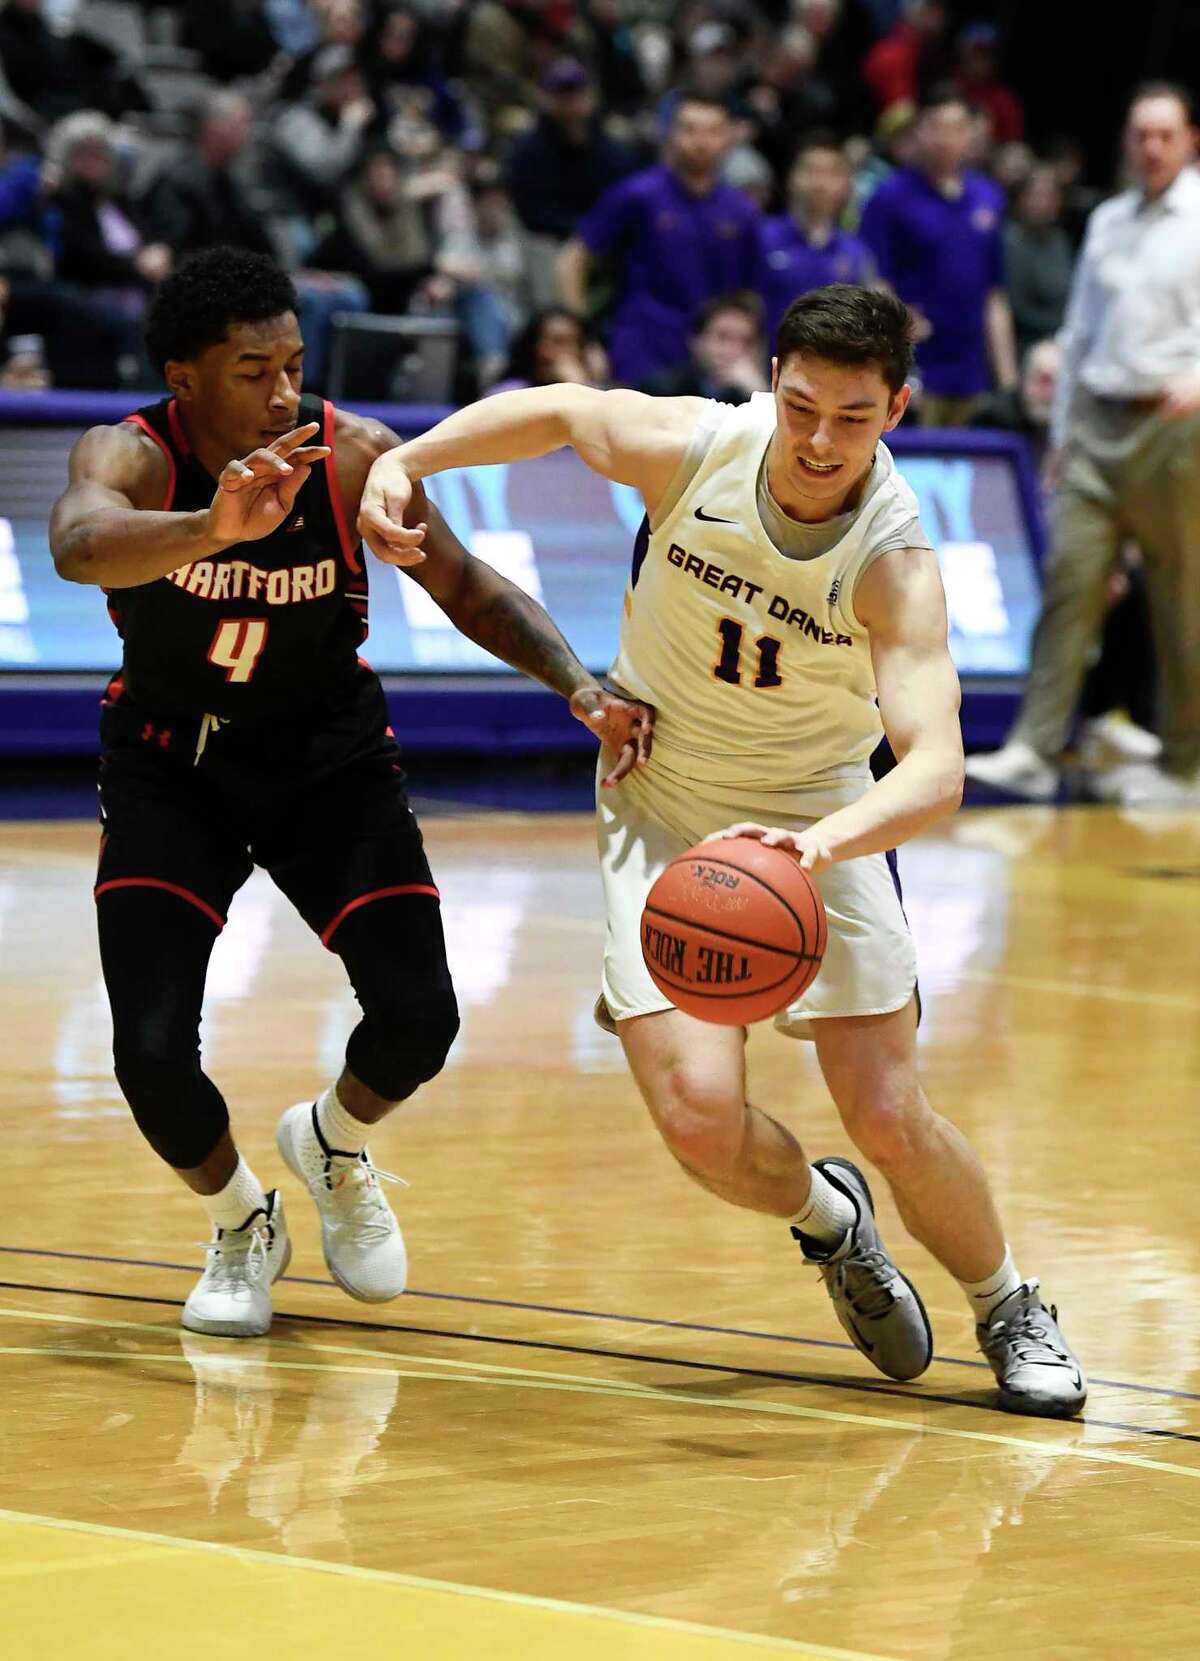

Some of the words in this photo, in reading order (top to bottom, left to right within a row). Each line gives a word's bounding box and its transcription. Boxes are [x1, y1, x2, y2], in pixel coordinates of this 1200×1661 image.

[667, 543, 764, 604] GREAT
[208, 618, 268, 682] 4
[711, 616, 784, 689] 11
[693, 865, 740, 889] ROCK
[645, 924, 688, 976] ROCK
[697, 946, 752, 984] THE
